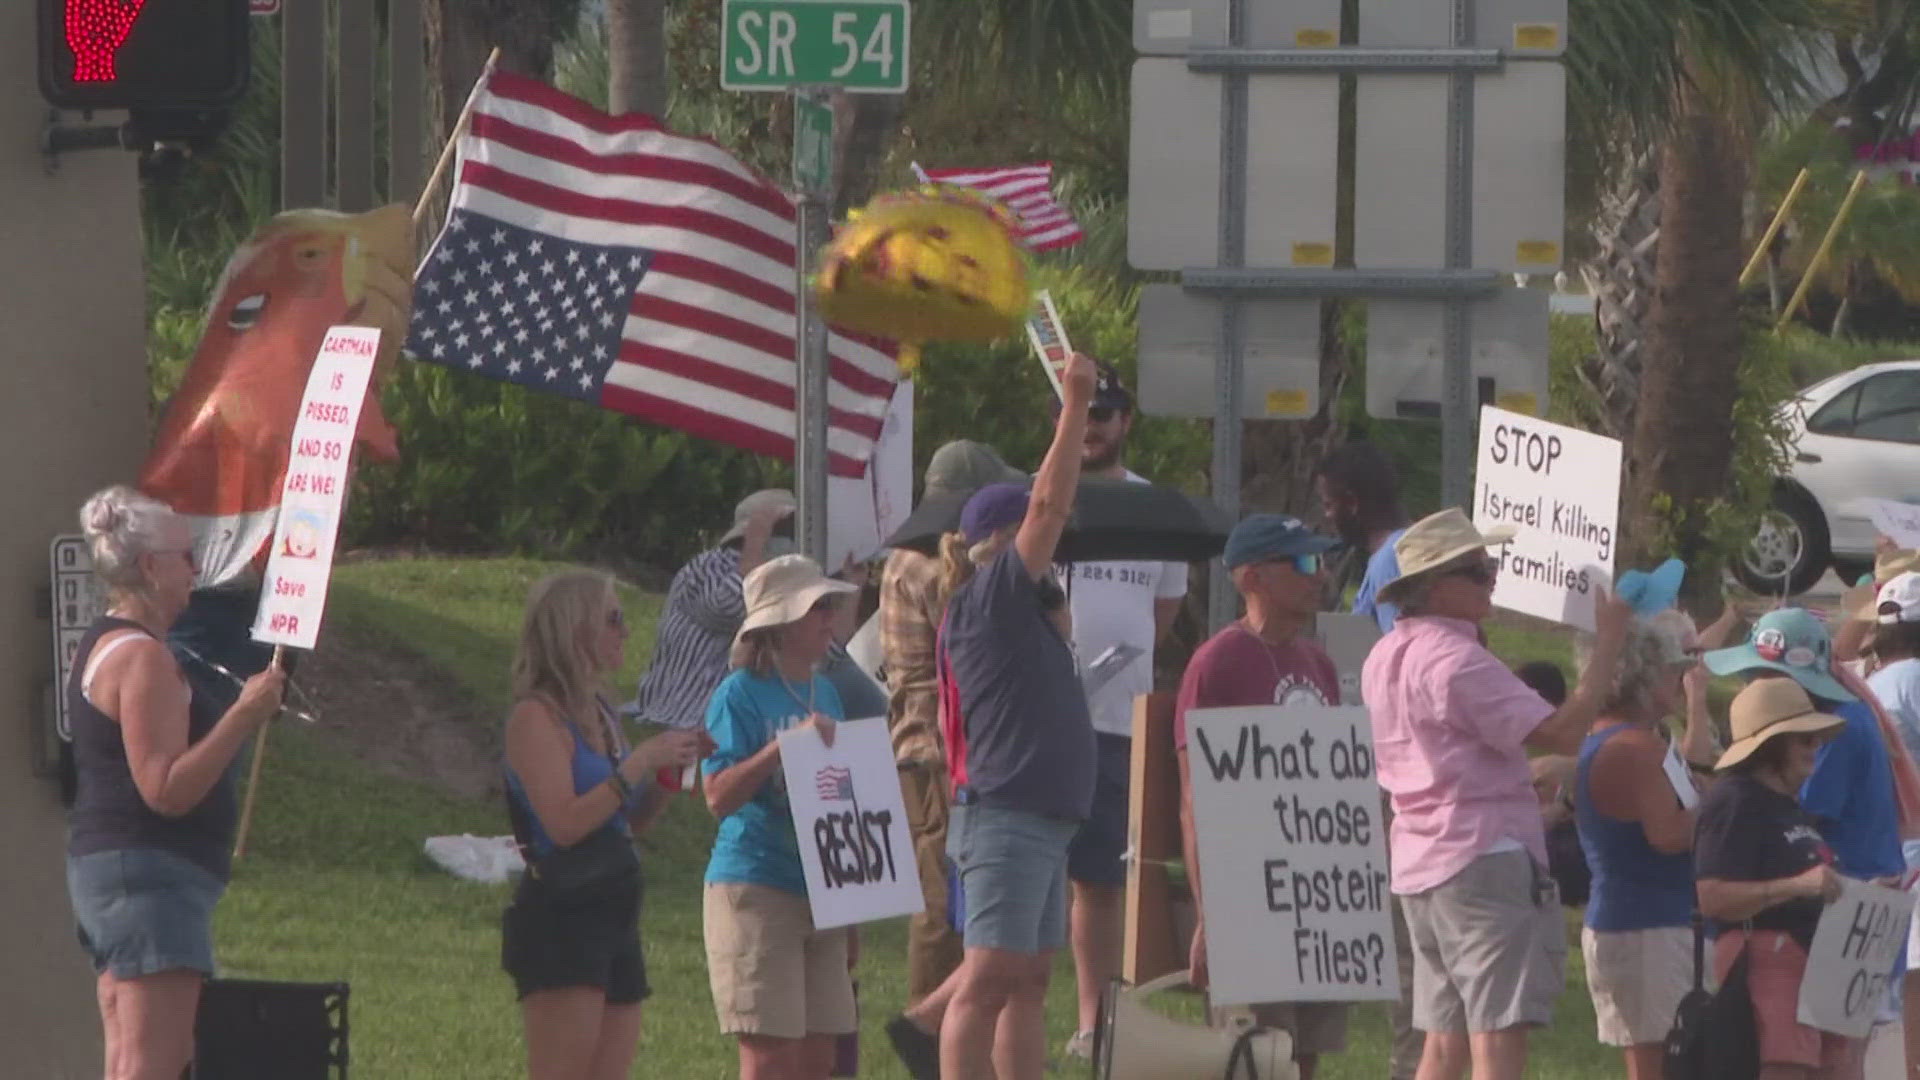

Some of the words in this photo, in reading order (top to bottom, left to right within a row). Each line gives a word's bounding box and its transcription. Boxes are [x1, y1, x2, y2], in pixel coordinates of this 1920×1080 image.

[735, 10, 797, 76] SR
[831, 12, 893, 78] 54
[324, 336, 374, 358] CARTMAN
[330, 371, 344, 391] IS
[297, 438, 320, 457] AND
[322, 441, 341, 460] SO
[1491, 424, 1562, 476] STOP
[288, 473, 308, 492] ARE
[1482, 483, 1543, 529] Israel
[1552, 499, 1611, 561] Killing
[275, 576, 306, 597] Save
[1083, 565, 1112, 581] 224
[1499, 539, 1590, 594] Families
[269, 612, 299, 635] NPR
[1197, 724, 1320, 782] What
[1330, 724, 1376, 780] ab
[1274, 795, 1371, 846] those
[814, 808, 897, 889] RESIST
[1294, 928, 1385, 986] Files?
